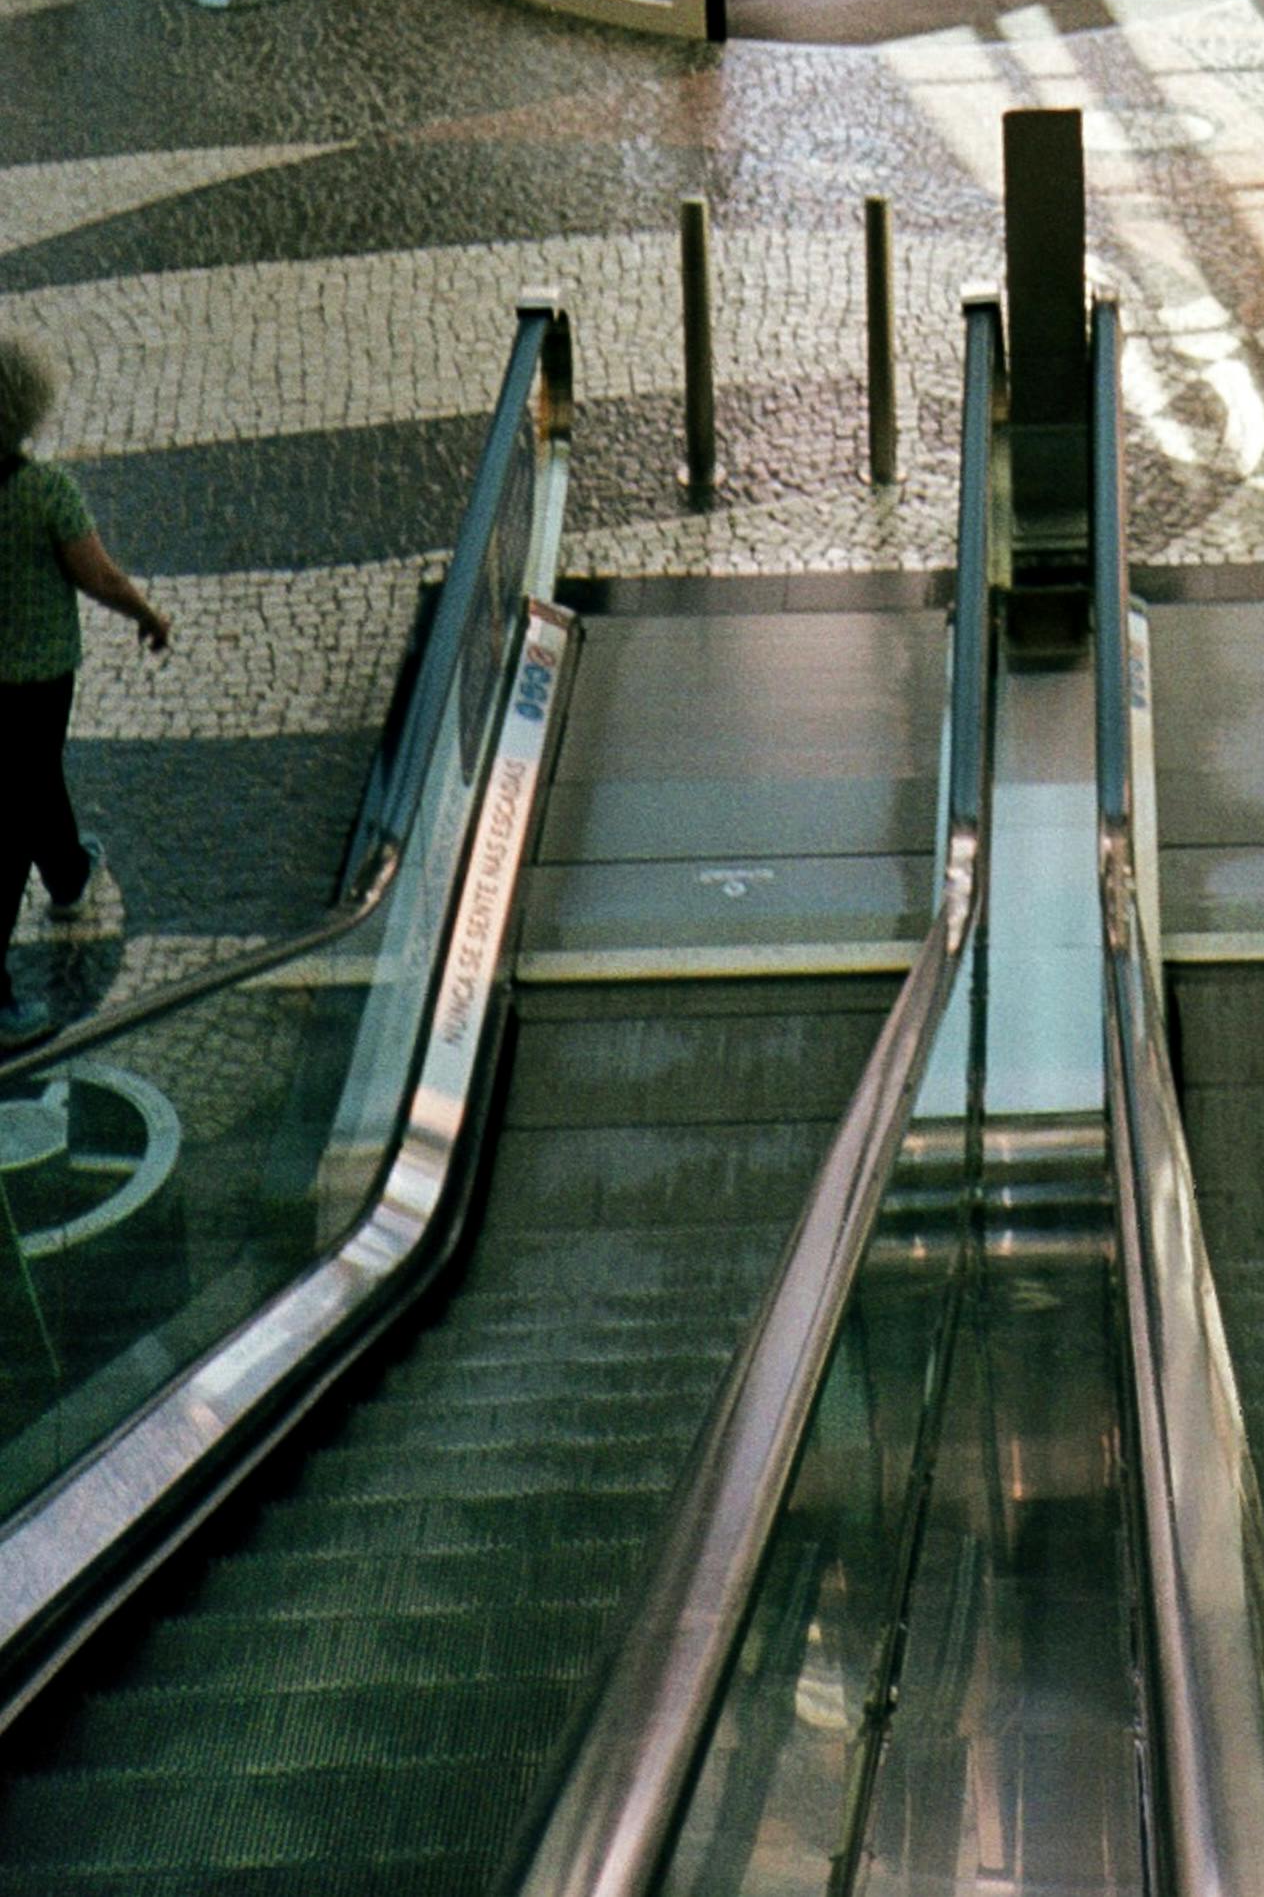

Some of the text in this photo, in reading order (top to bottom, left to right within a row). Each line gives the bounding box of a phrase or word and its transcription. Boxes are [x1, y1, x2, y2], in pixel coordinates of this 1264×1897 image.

[443, 757, 527, 1046] NUNCA SE SENTE NAS ESCADAS
